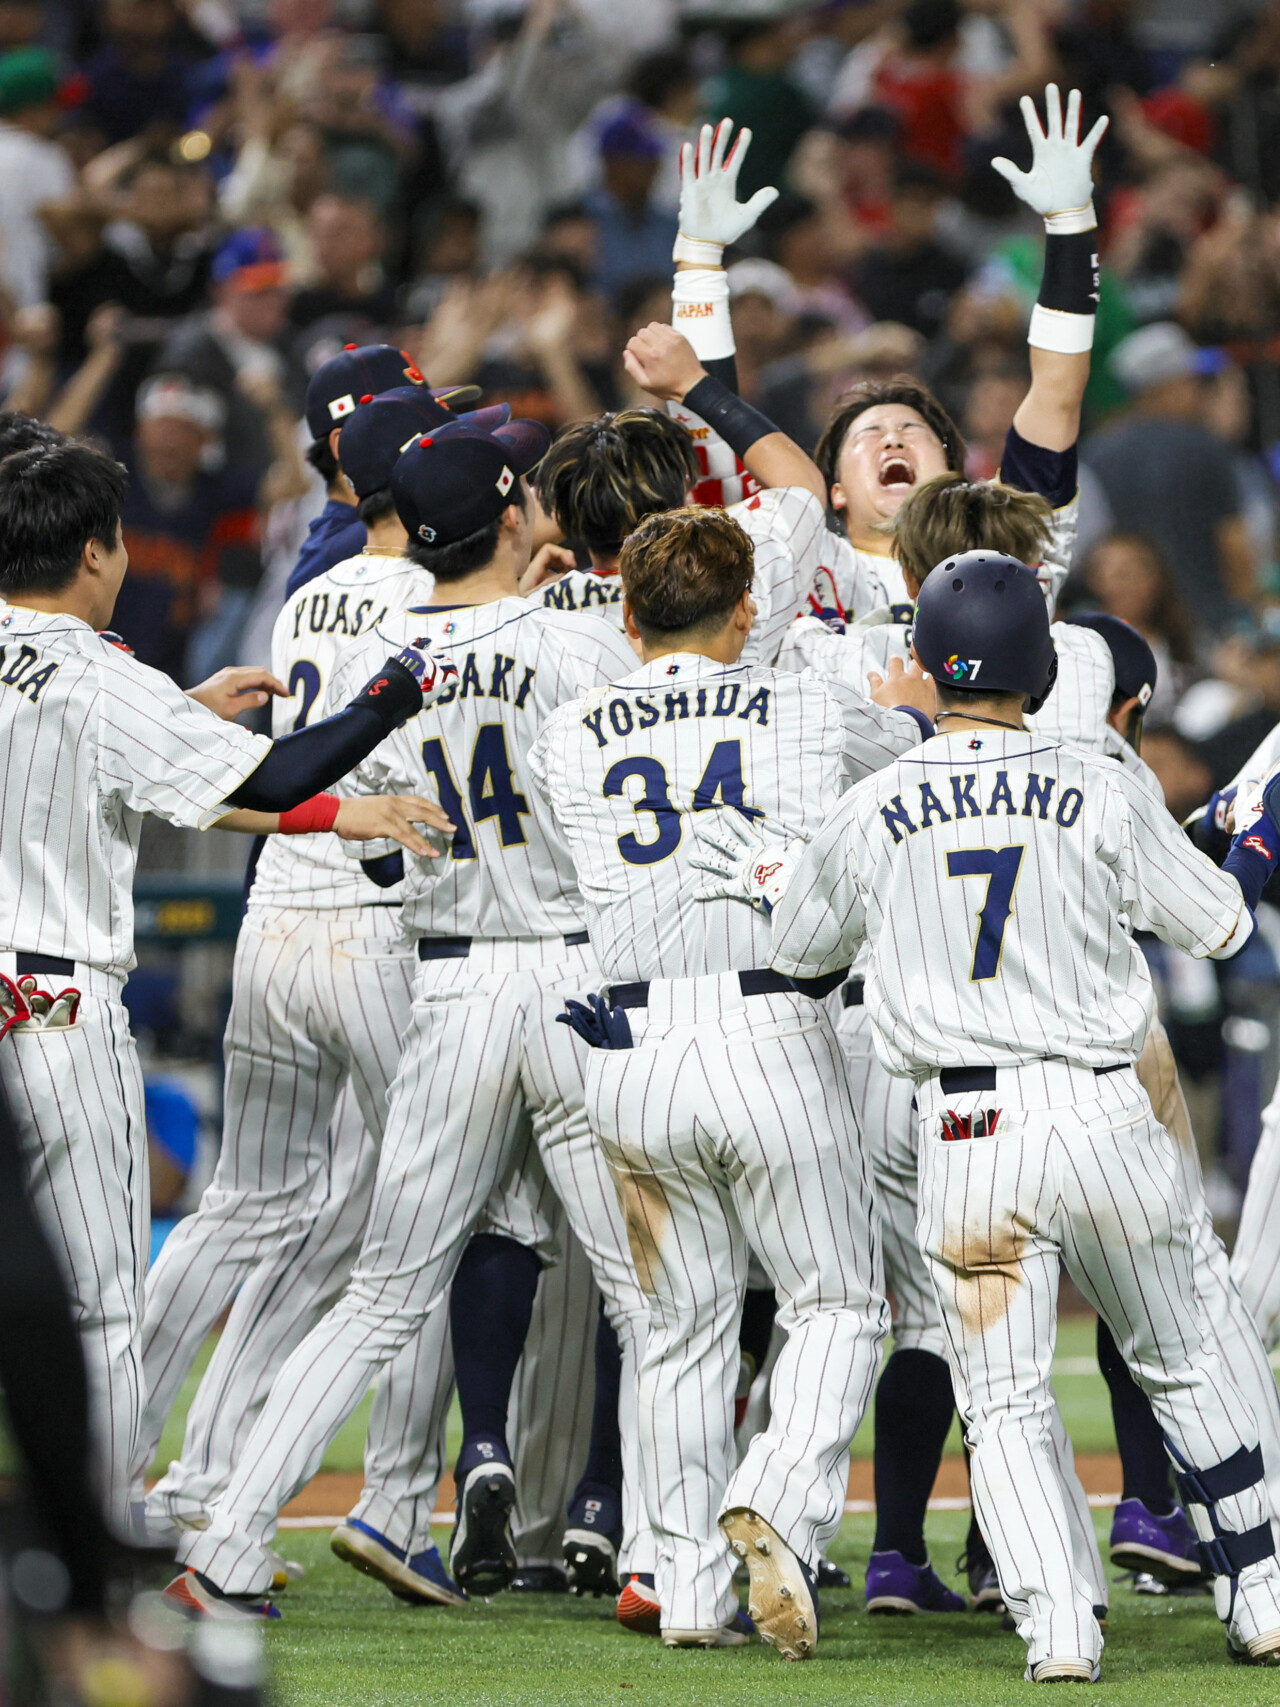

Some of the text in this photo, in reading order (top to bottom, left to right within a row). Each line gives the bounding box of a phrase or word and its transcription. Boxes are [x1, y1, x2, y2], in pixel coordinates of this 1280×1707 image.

[0, 643, 59, 704] DA
[968, 659, 983, 681] 7
[582, 683, 771, 749] YOSHIDA
[420, 722, 532, 863] 14
[603, 738, 768, 868] 34
[880, 770, 1084, 845] NAKANO
[944, 842, 1027, 983] 7
